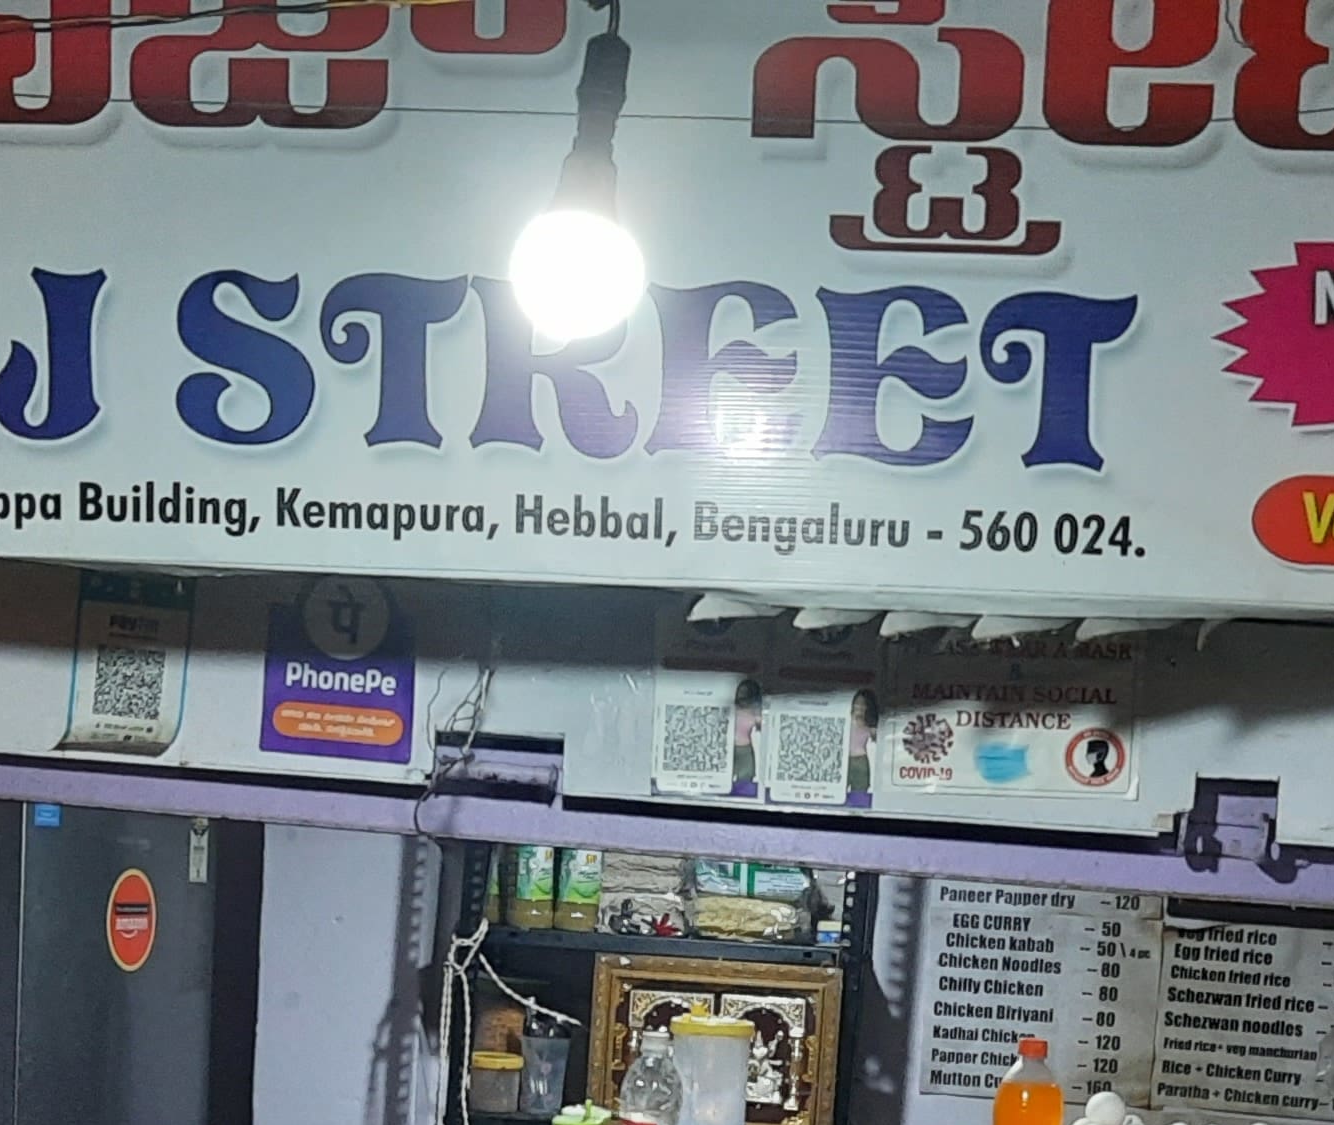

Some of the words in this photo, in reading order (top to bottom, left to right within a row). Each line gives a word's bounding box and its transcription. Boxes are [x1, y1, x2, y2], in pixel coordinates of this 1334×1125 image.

[176, 268, 1139, 475] STREET
[78, 480, 261, 537] Building,
[275, 486, 499, 542] Kemapura,
[514, 495, 677, 549] Hebbal,
[693, 502, 909, 560] Bengaluru
[959, 510, 1039, 554] 560
[1053, 513, 1147, 561] 024.
[285, 661, 397, 696] PhonePe
[912, 682, 1021, 702] MAINTAIN
[1033, 686, 1116, 705] SOCIAL
[956, 709, 1071, 730] DISTANCE
[940, 886, 993, 904] Paneer
[1051, 891, 1075, 909] dry
[1115, 895, 1141, 911] 120
[953, 913, 979, 929] EGG
[983, 914, 1031, 932] CURRY
[1101, 921, 1121, 938] 50
[1208, 928, 1244, 944] fried
[1247, 930, 1277, 946] rice
[946, 932, 1007, 951] Chicken
[1009, 936, 1055, 953] kabab
[1097, 942, 1116, 957] 50
[1174, 943, 1200, 961] Egg
[1204, 946, 1239, 963] fried
[1243, 949, 1273, 965] rice
[938, 952, 998, 971] Chicken
[1002, 955, 1062, 975] Noodles
[1171, 965, 1225, 982] Chicken
[1229, 969, 1260, 985] fried
[1264, 973, 1291, 987] rice
[984, 979, 1044, 997] Chicken
[1168, 987, 1242, 1007] Schezwan
[1245, 994, 1281, 1011] fried
[1285, 997, 1315, 1013] rice
[934, 1001, 993, 1019] Chicken
[997, 1004, 1054, 1023] Biriyani
[1165, 1011, 1239, 1032] Schezwan
[1242, 1018, 1303, 1037] noodles
[933, 1025, 978, 1042] Kadhai
[1096, 1035, 1121, 1051] 120
[1164, 1037, 1192, 1050] Fried
[1227, 1045, 1246, 1057] veg
[1249, 1046, 1317, 1061] manchurian
[981, 1051, 1020, 1067] Chick
[1093, 1058, 1118, 1074] 120
[1162, 1060, 1191, 1075] Rice
[1206, 1063, 1261, 1082] Chicken
[1264, 1069, 1302, 1086] Curry
[930, 1070, 980, 1088] Mutton
[1157, 1083, 1210, 1100] Paratha
[1224, 1088, 1279, 1106] Chicken
